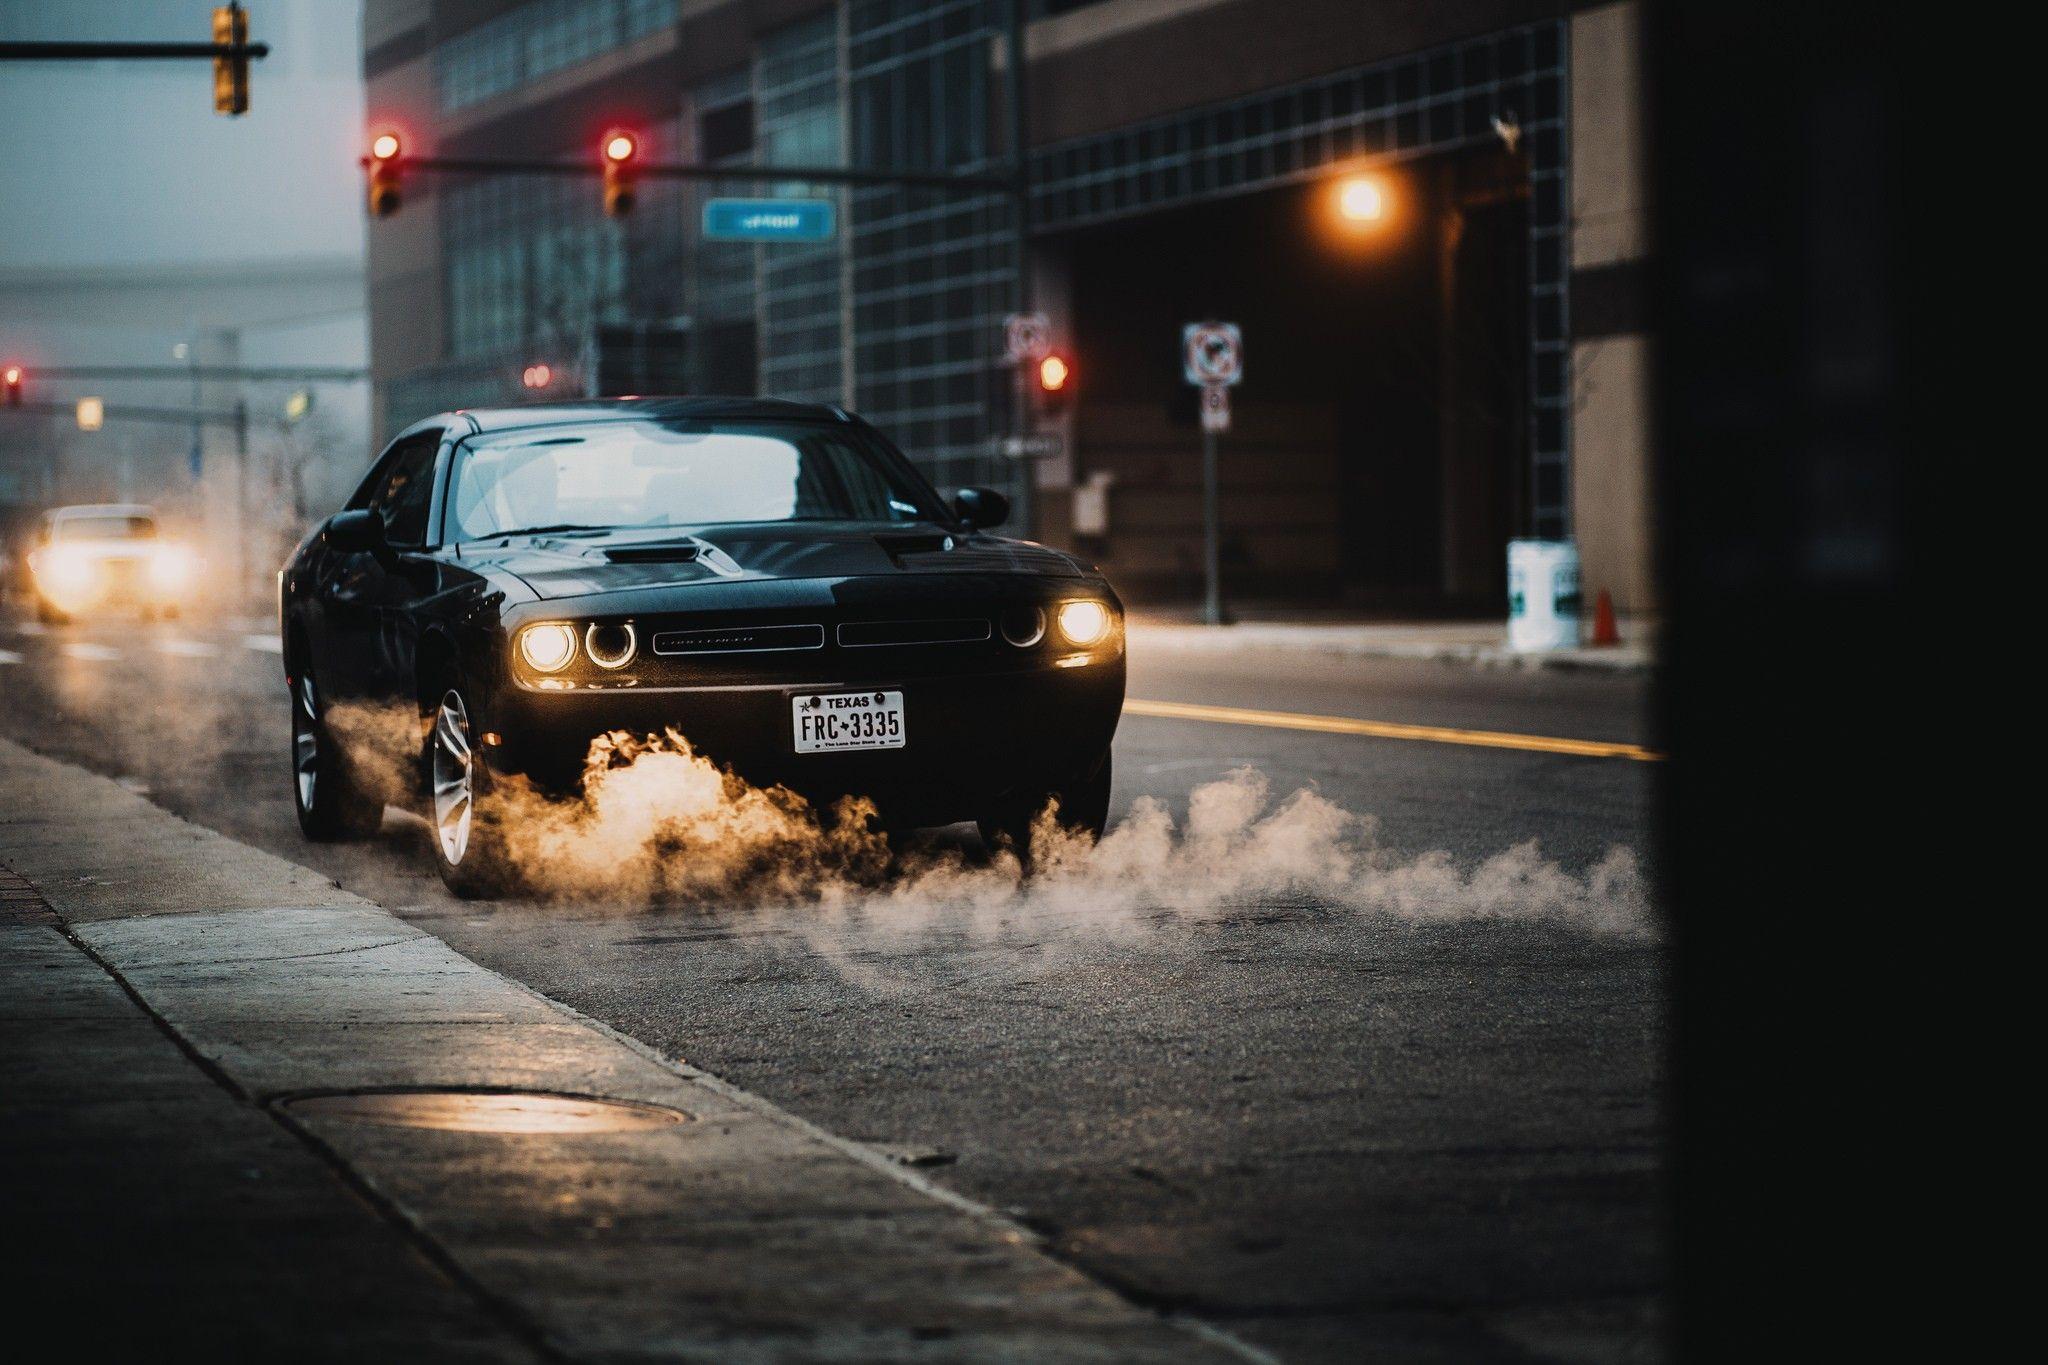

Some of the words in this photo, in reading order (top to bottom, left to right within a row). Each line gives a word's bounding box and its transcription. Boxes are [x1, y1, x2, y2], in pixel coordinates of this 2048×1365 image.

[827, 696, 870, 709] TEXAS
[802, 714, 838, 741] FRC
[850, 711, 899, 738] 3335
